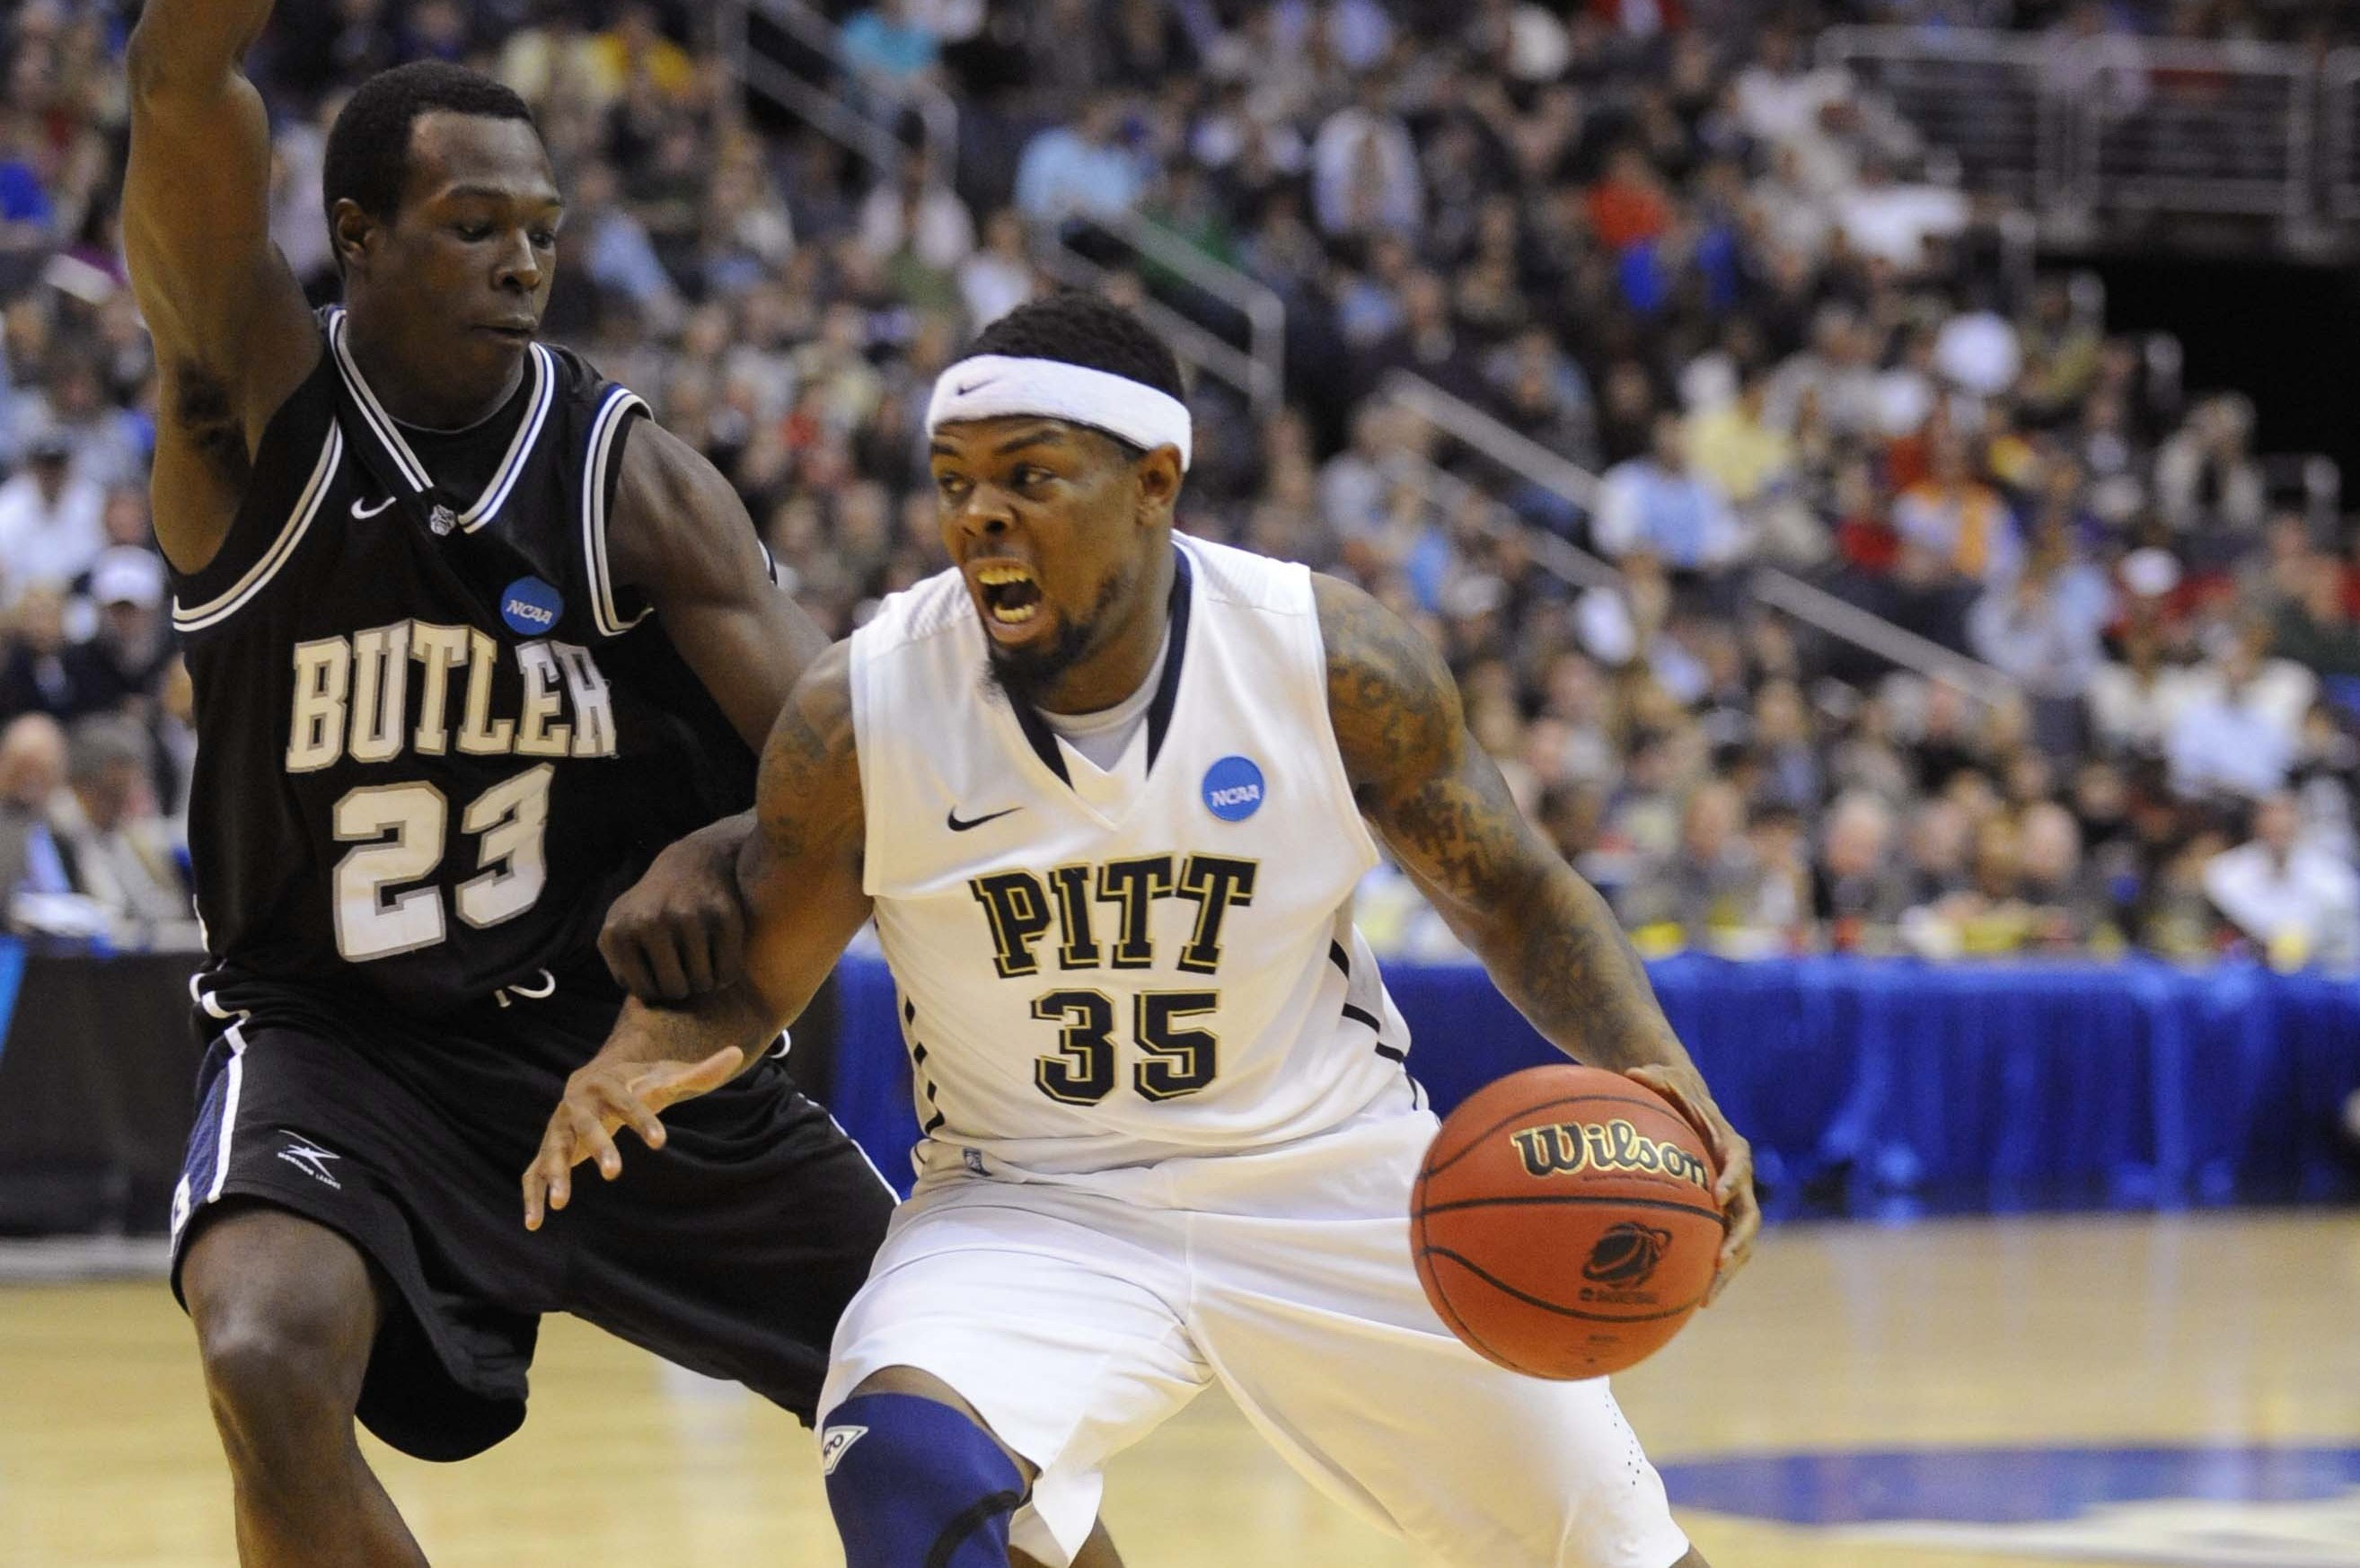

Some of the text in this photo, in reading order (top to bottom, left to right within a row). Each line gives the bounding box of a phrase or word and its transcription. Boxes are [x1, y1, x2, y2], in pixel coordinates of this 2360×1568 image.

[506, 599, 553, 625] NCAA
[286, 619, 618, 773] BUTLER
[1210, 784, 1260, 807] NCAA
[332, 762, 555, 963] 23
[968, 850, 1260, 979] PITT
[1031, 988, 1221, 1107] 35
[1510, 1119, 1711, 1194] Wilson
